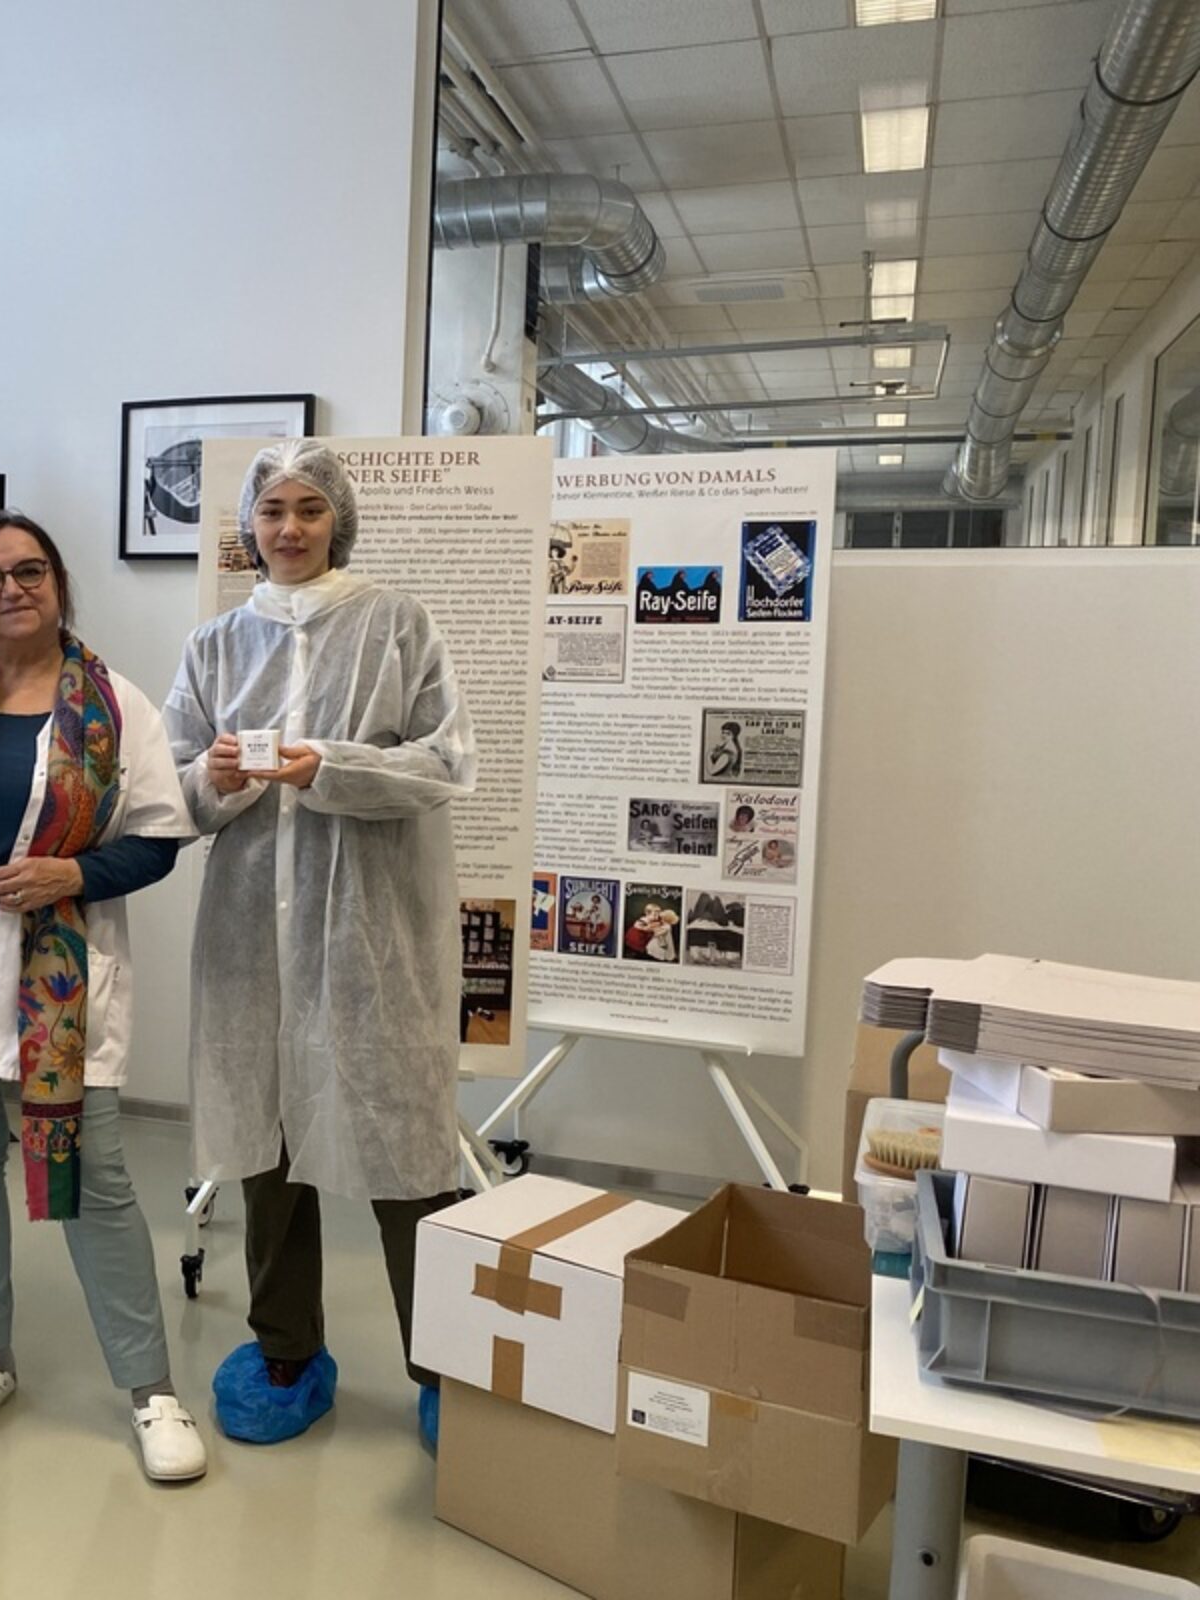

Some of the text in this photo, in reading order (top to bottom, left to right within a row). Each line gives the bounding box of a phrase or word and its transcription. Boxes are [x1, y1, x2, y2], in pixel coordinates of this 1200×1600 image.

[337, 451, 481, 466] SCHICHTE DER
[347, 469, 386, 483] NER
[557, 468, 777, 489] WERBUNG VON DAMALS
[359, 485, 495, 496] Apollo und Friedrich Weiss
[557, 489, 581, 501] bevor
[699, 486, 706, 497] &
[708, 486, 721, 497] Co
[722, 485, 738, 497] das
[742, 485, 771, 498] Sagen
[640, 590, 717, 615] Ray-Seife
[746, 585, 805, 608] Hochdorfer
[547, 615, 603, 625] AY-SEIFE
[673, 813, 718, 831] Seifen
[675, 837, 714, 856] Teint
[565, 879, 615, 901] SUNLIGHT
[568, 942, 607, 955] SEIFE
